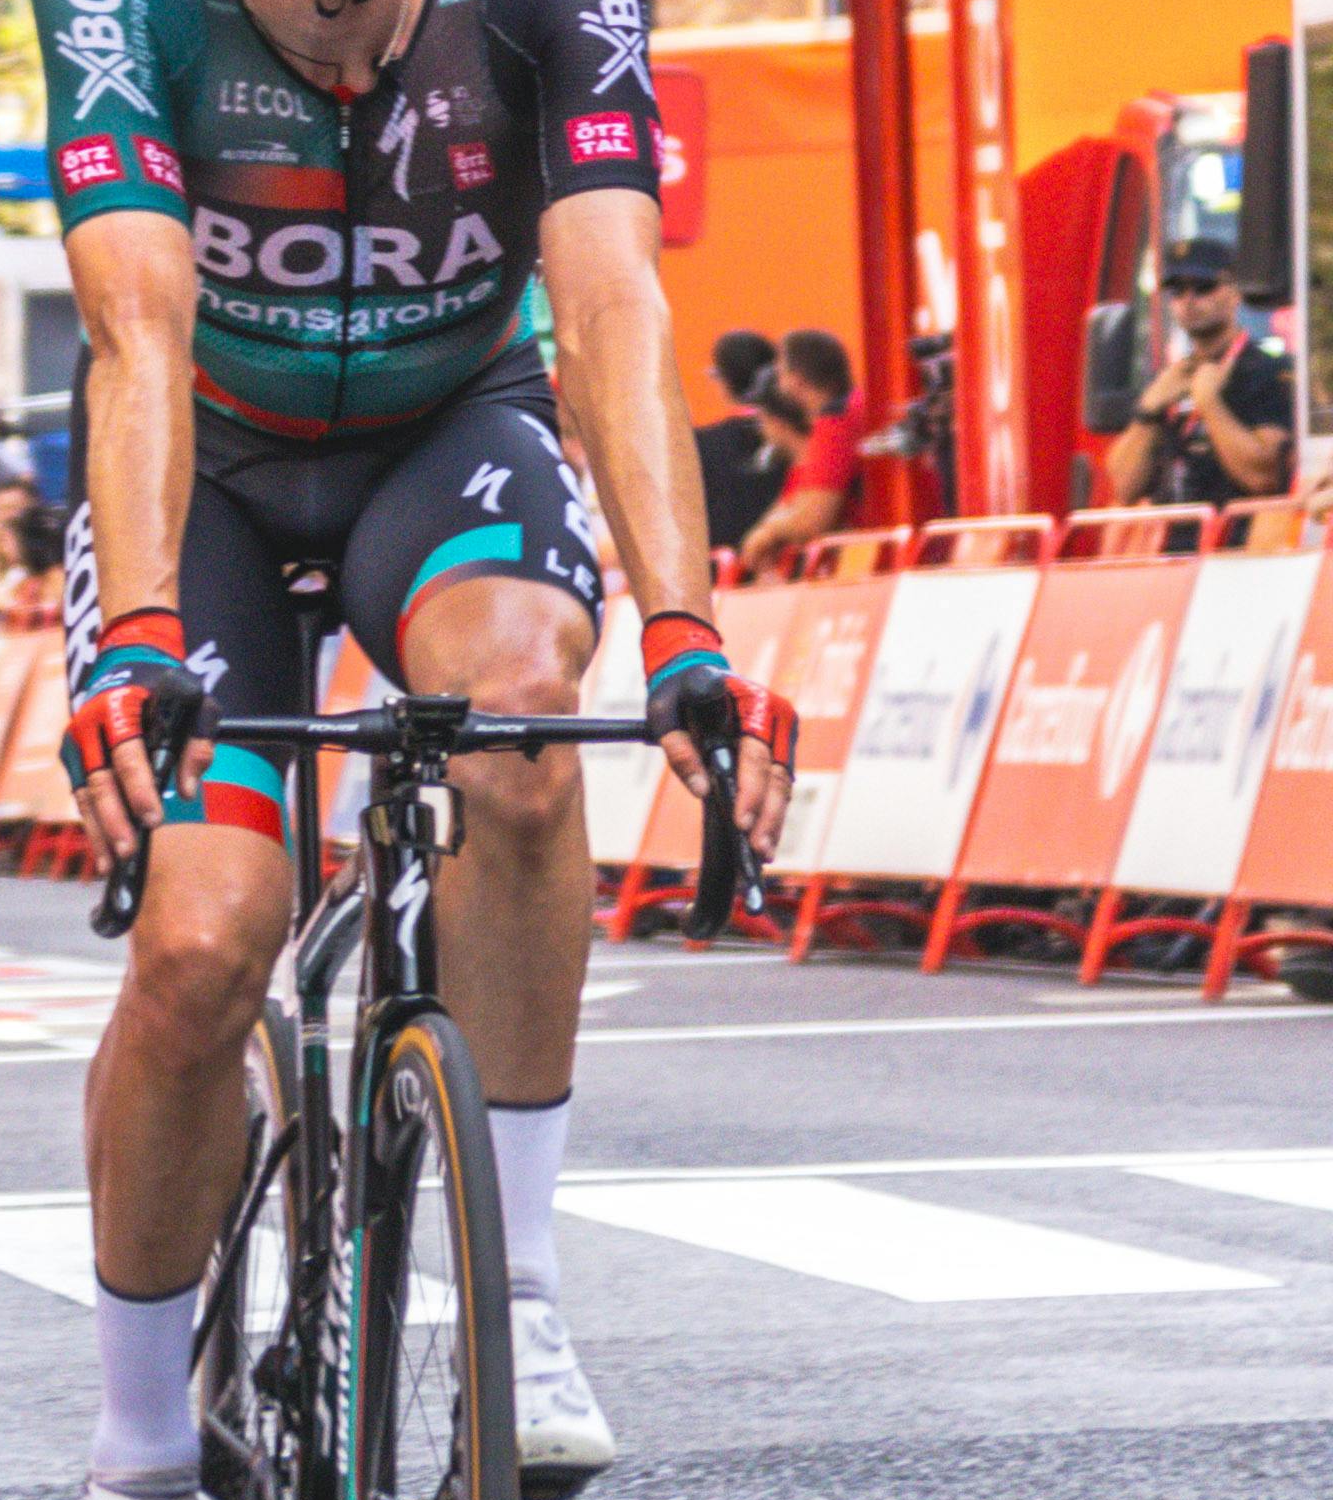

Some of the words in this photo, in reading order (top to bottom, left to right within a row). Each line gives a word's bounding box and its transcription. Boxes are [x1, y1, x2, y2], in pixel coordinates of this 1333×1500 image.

[219, 80, 250, 115] LE
[254, 84, 314, 123] COL
[576, 138, 632, 155] TAL
[66, 161, 117, 185] TAL
[194, 205, 504, 288] BORA
